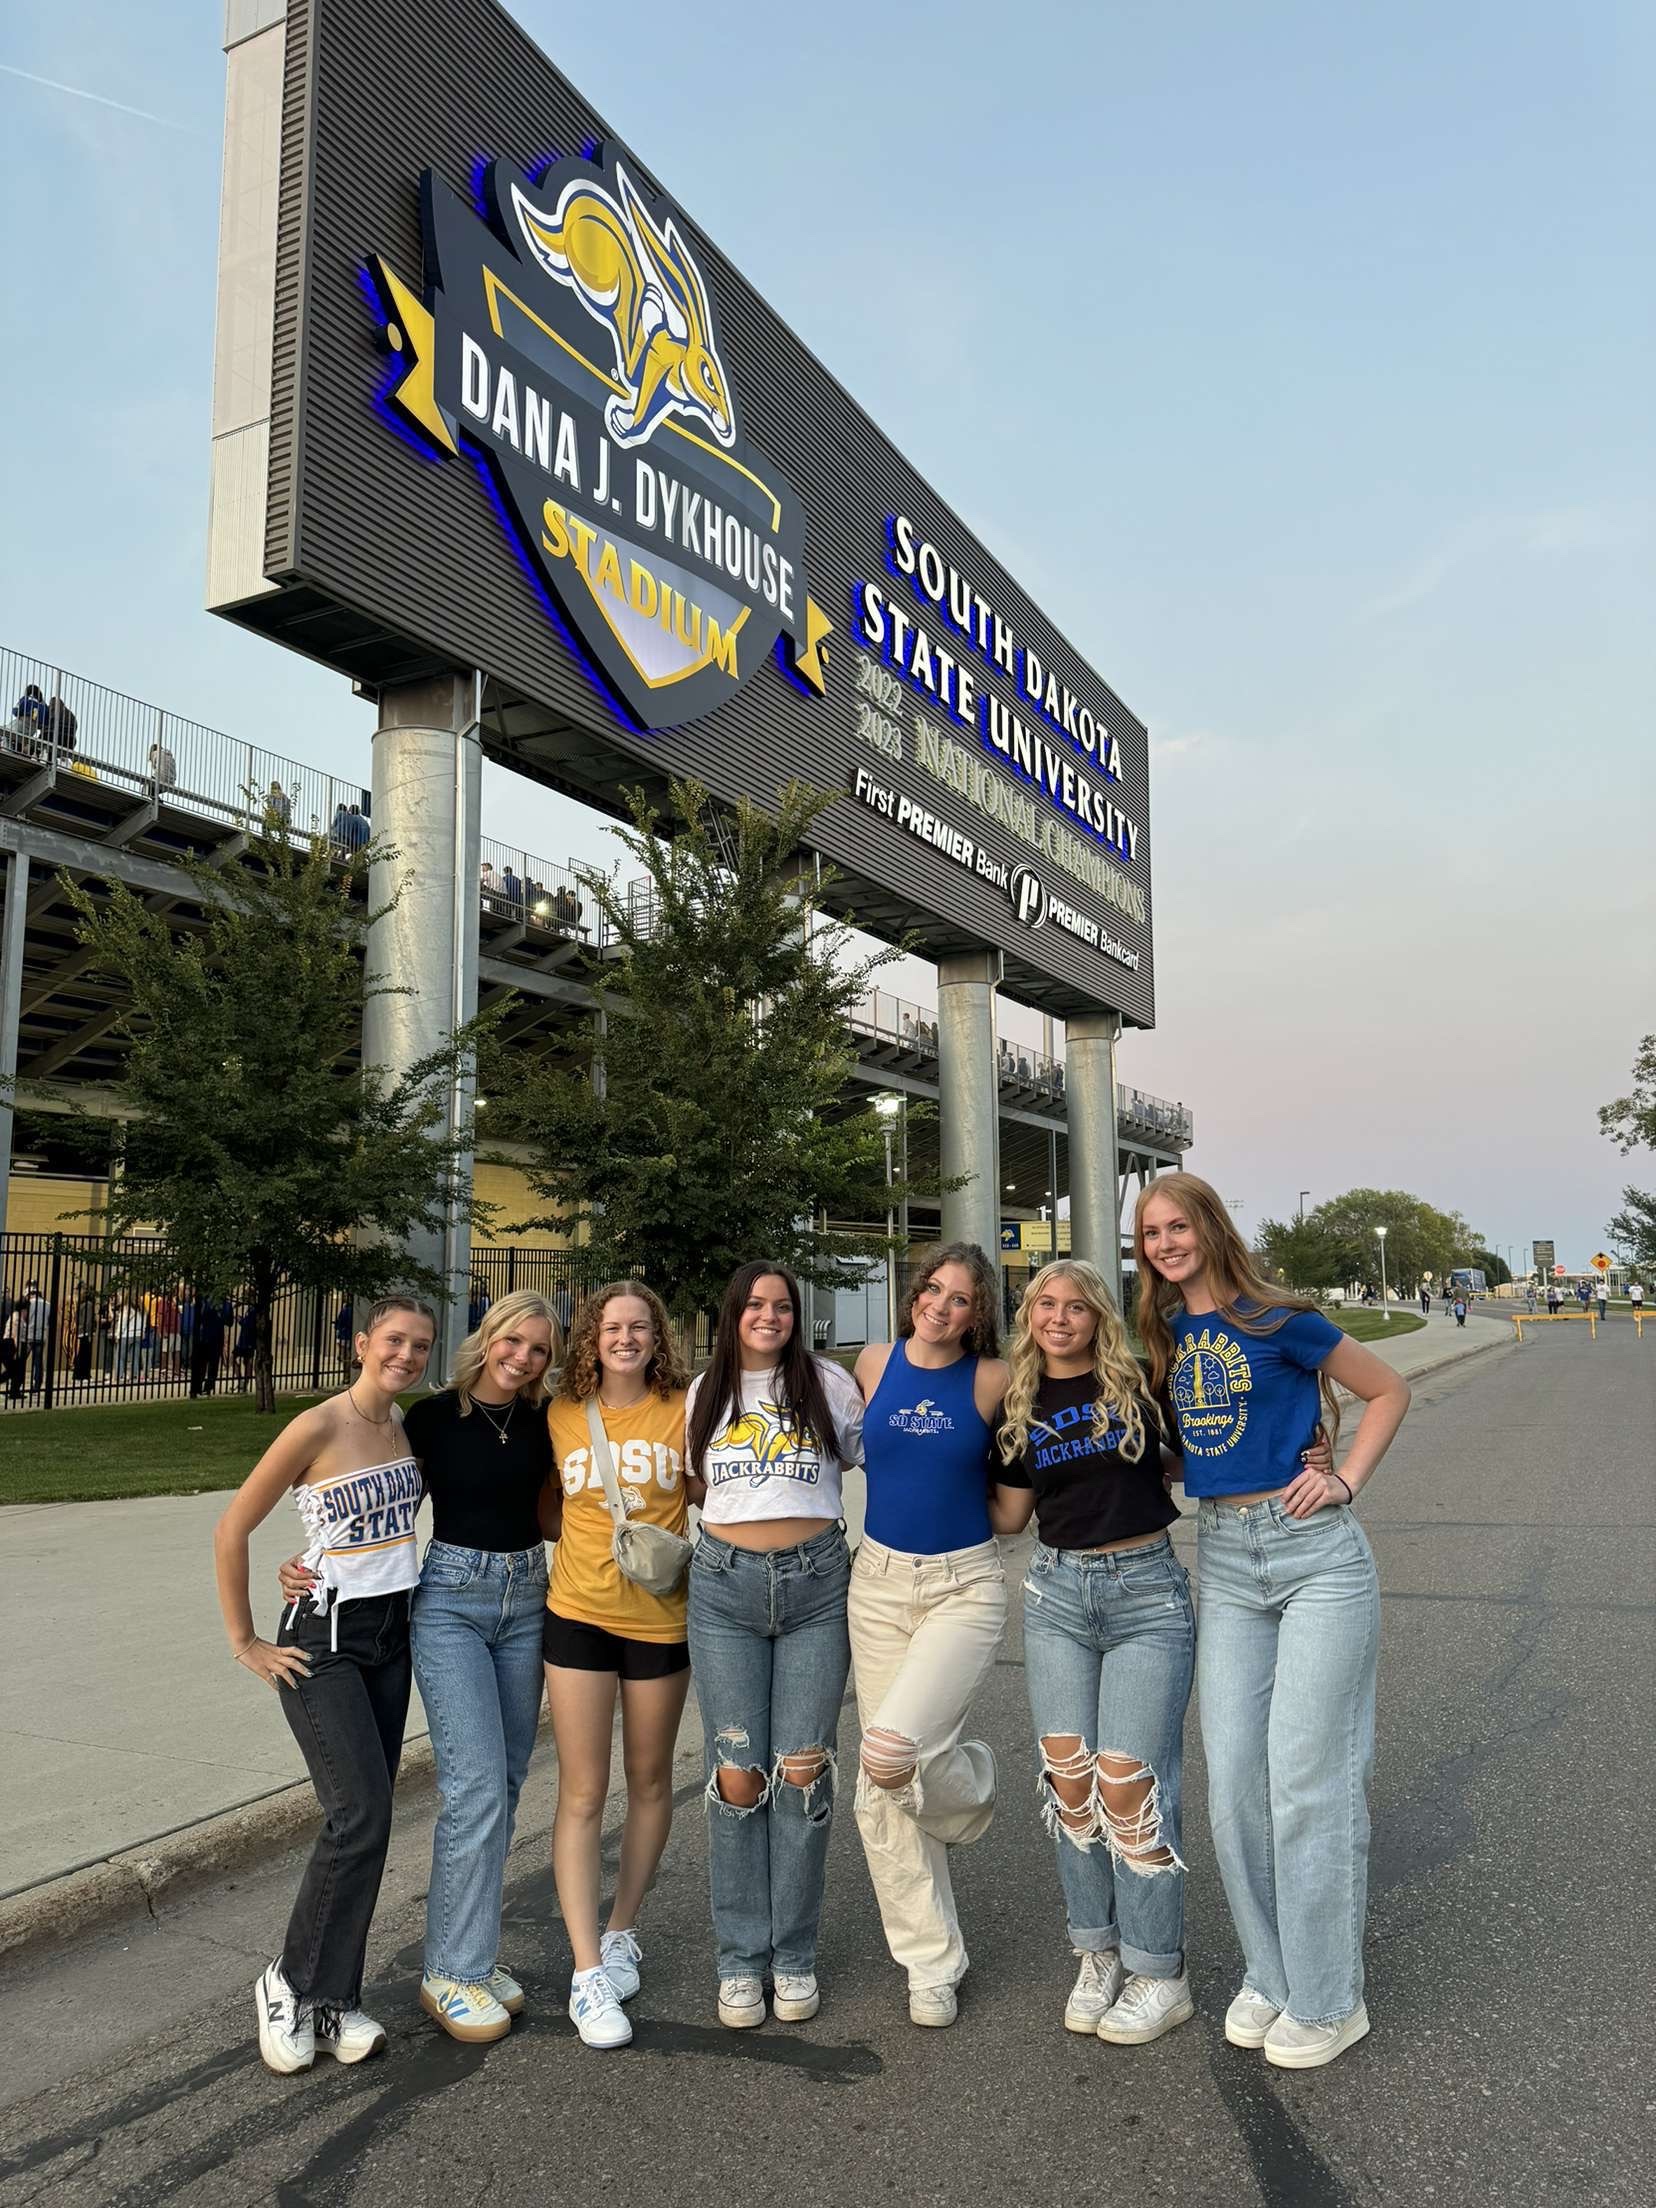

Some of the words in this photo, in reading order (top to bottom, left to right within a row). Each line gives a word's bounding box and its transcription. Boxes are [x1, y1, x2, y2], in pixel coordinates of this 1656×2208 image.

[461, 331, 581, 492] DANA
[593, 436, 622, 513] J.
[635, 458, 795, 624] DYKHOUSE
[541, 497, 740, 681] STADIUM
[896, 516, 1015, 676] SOUTH
[1026, 648, 1123, 782] DAKOTA
[864, 583, 976, 725] STATE
[989, 694, 1139, 862] UNIVERSITY
[855, 767, 895, 819] First
[897, 795, 974, 869] PREMIER
[975, 847, 1009, 891] Bank
[912, 715, 1044, 852] NATIONAL
[1044, 818, 1146, 925] CHAMPIONS
[1048, 894, 1098, 947] PREMIER
[1100, 929, 1140, 972] Bankcard
[889, 1414, 909, 1427] SD
[910, 1416, 953, 1430] STATE
[1182, 1412, 1234, 1429] Brookings
[1205, 1443, 1228, 1457] STATE
[1226, 1400, 1248, 1448] UNIVERSITY
[323, 1474, 385, 1523] SOUTH
[712, 1461, 819, 1485] JACKRABBITS
[350, 1501, 418, 1543] STAT
